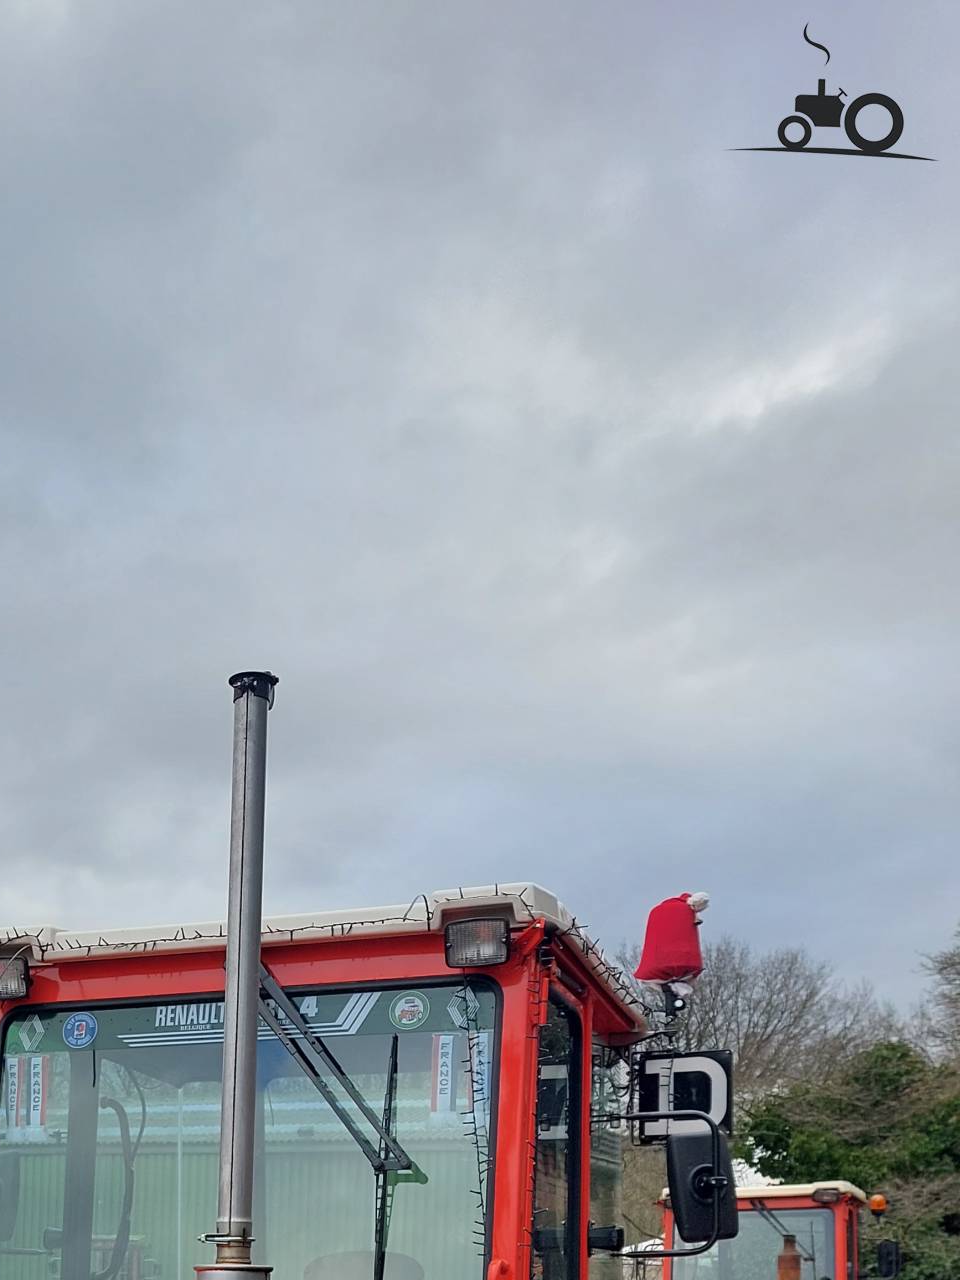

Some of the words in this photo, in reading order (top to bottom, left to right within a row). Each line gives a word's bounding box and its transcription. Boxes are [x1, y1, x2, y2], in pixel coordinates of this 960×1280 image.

[9, 1064, 17, 1111] FRANCE
[32, 1063, 41, 1111] FRANCE
[440, 1042, 451, 1095] FRANCE
